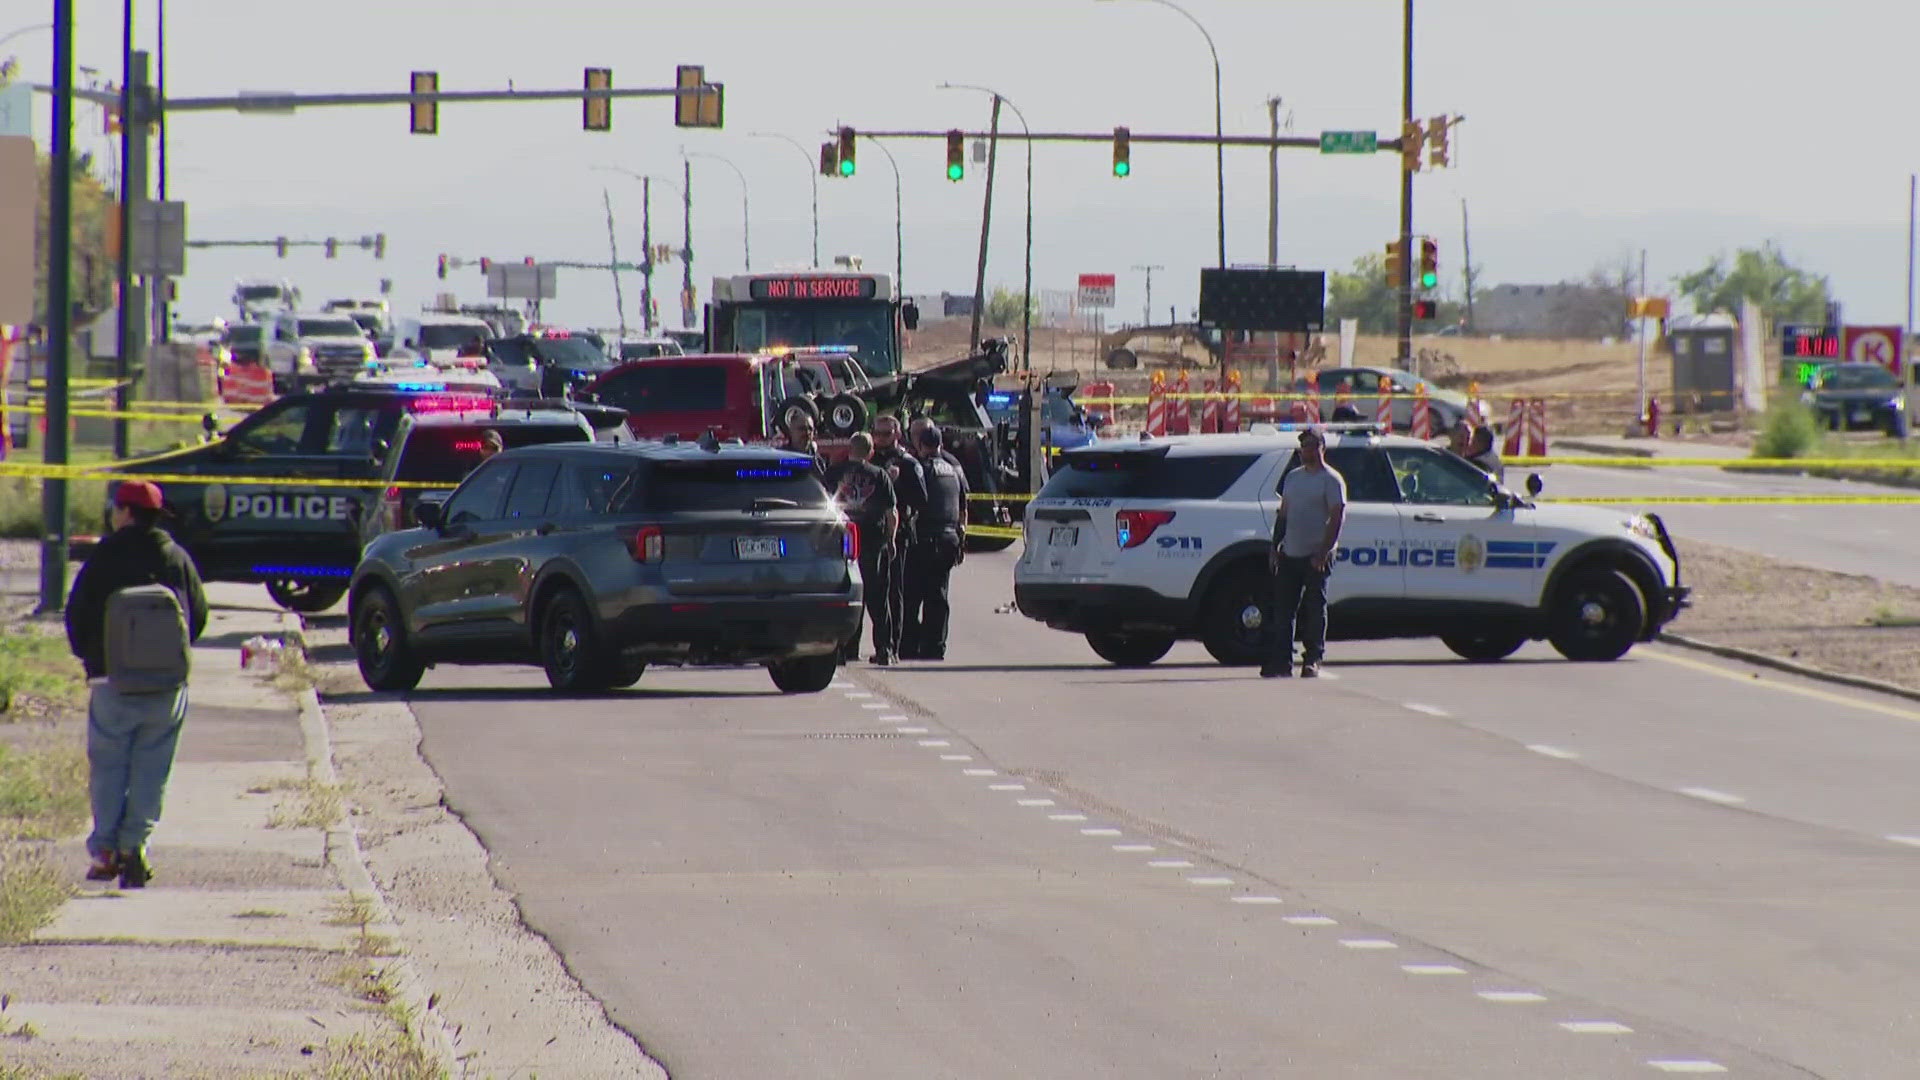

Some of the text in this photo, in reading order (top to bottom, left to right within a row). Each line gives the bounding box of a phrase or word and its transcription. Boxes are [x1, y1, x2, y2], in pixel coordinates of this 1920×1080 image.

[768, 279, 860, 297] NOT IN SERVICE
[1864, 342, 1886, 363] K
[229, 494, 347, 520] POLICE
[1155, 535, 1203, 550] 911
[1335, 547, 1456, 568] POLICE
